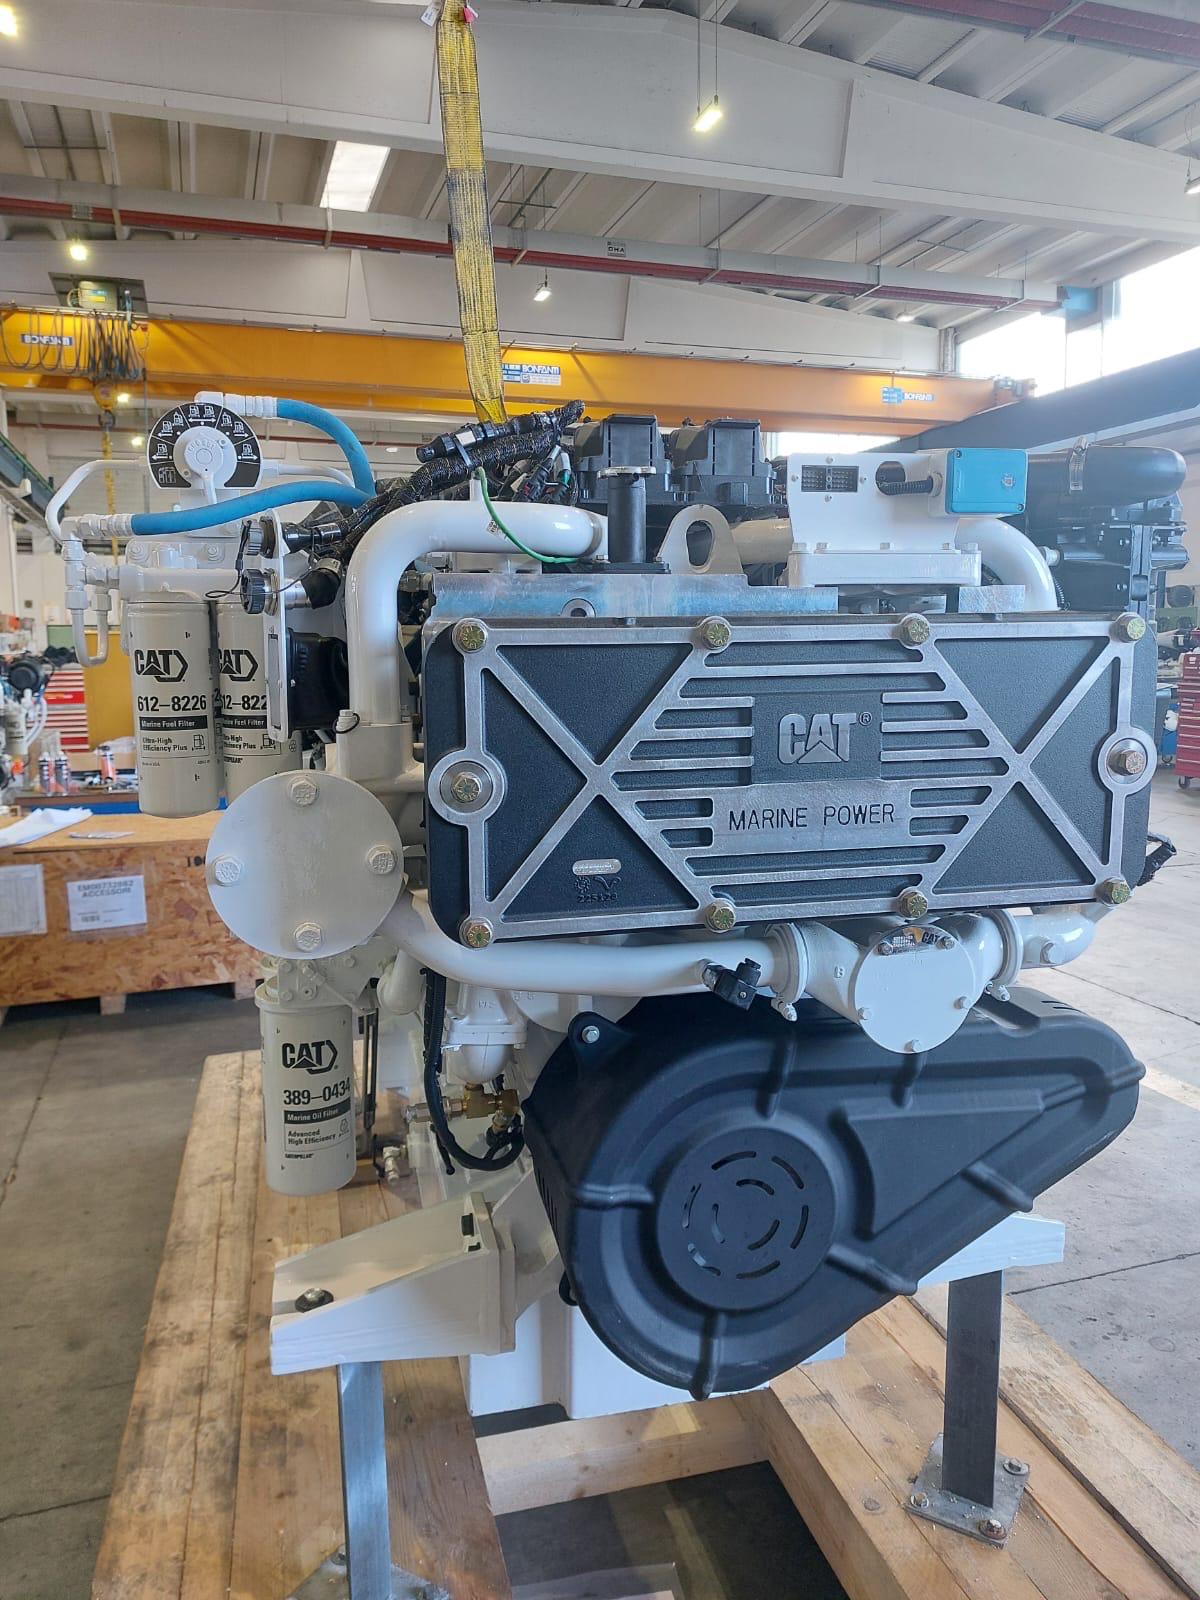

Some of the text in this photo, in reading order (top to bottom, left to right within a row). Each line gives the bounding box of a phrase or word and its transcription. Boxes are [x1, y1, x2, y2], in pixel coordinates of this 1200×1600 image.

[522, 365, 559, 375] BONFANTI
[134, 649, 171, 675] CAT
[137, 694, 207, 712] 612-8226
[141, 720, 161, 728] Marine
[178, 719, 195, 727] Filter
[729, 803, 895, 831] MARINE POWER
[282, 1040, 326, 1068] CAT
[283, 1077, 351, 1105] 389-0434
[287, 1113, 311, 1121] Marine
[323, 1108, 338, 1117] Filter
[288, 1129, 320, 1137] Advanced
[288, 1138, 303, 1146] High
